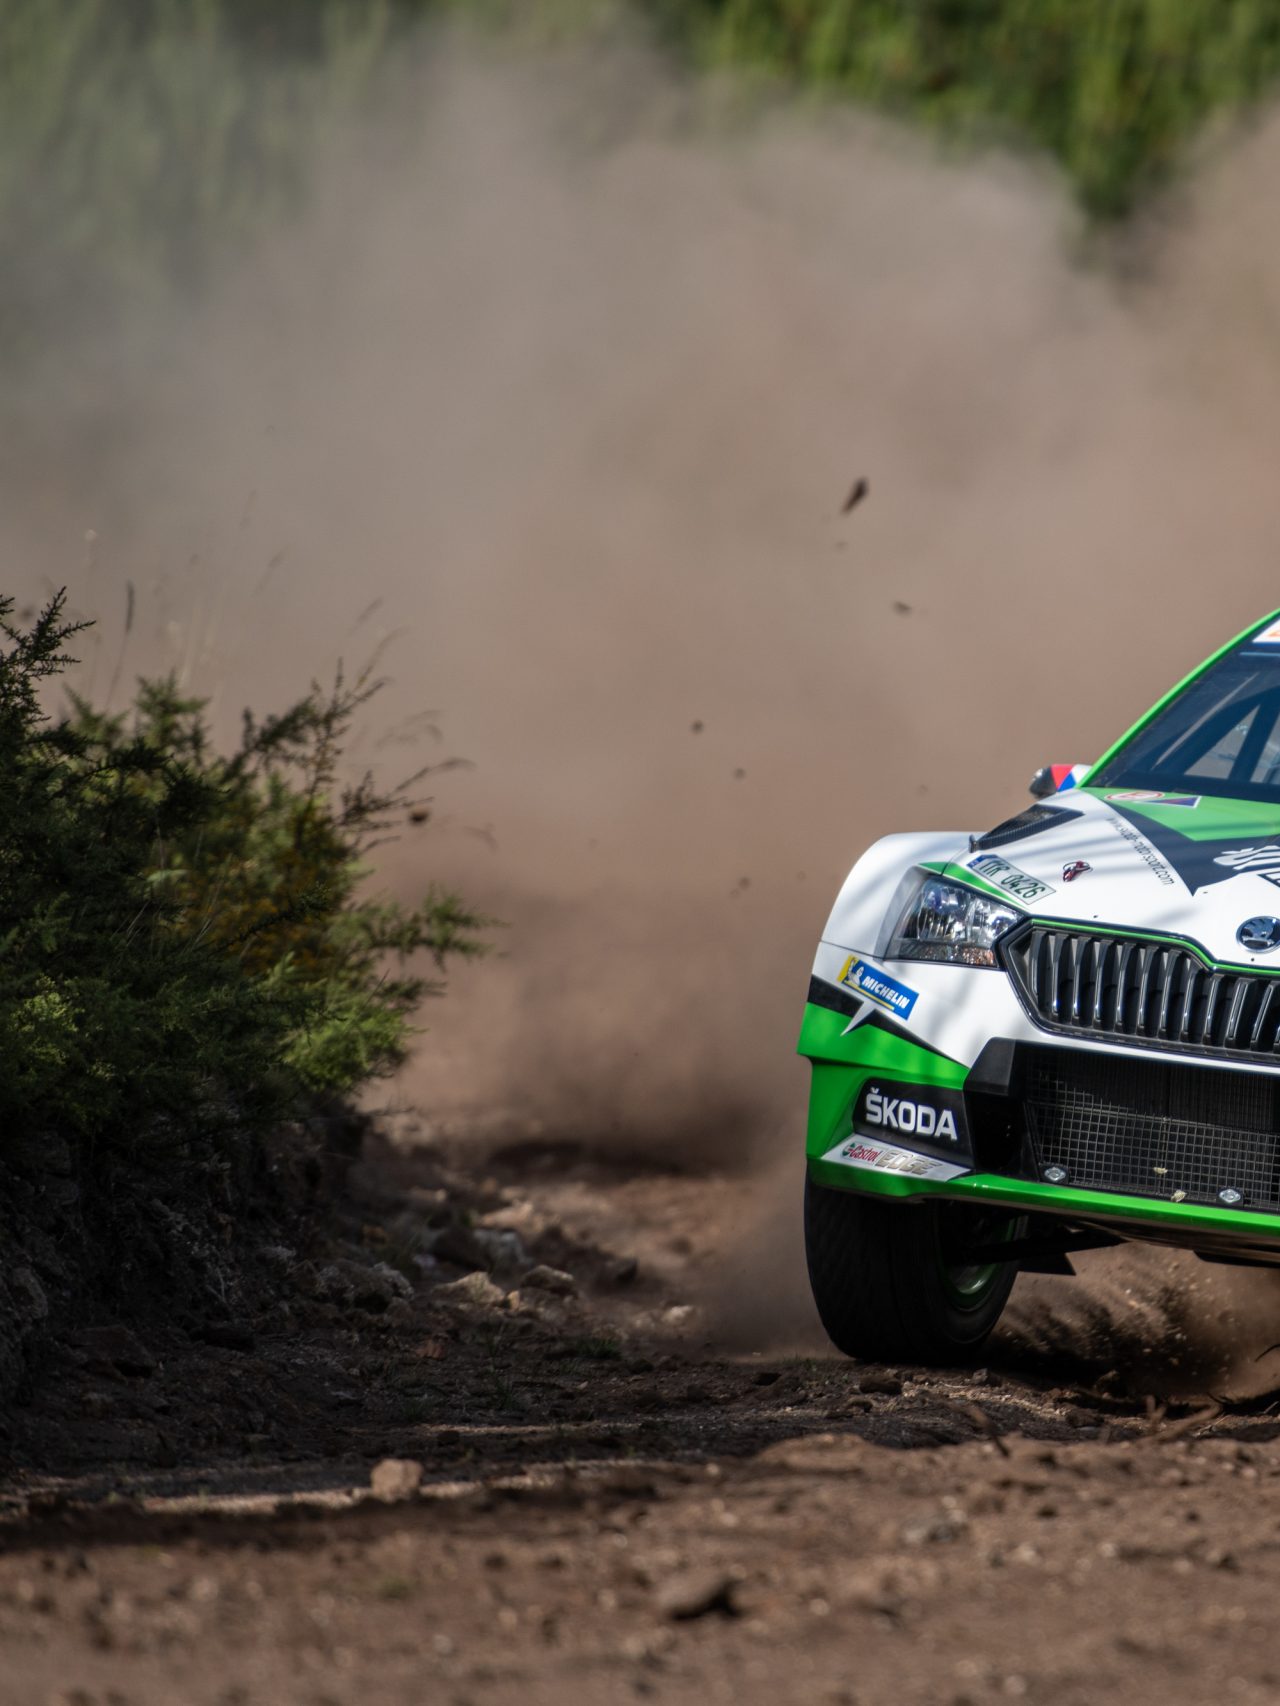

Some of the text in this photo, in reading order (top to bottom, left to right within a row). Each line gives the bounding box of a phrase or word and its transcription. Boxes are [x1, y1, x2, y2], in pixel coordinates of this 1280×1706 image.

[861, 974, 911, 1010] MICHELIN
[865, 1086, 958, 1141] ŠKODA
[848, 1144, 943, 1176] Castrol EDGE
